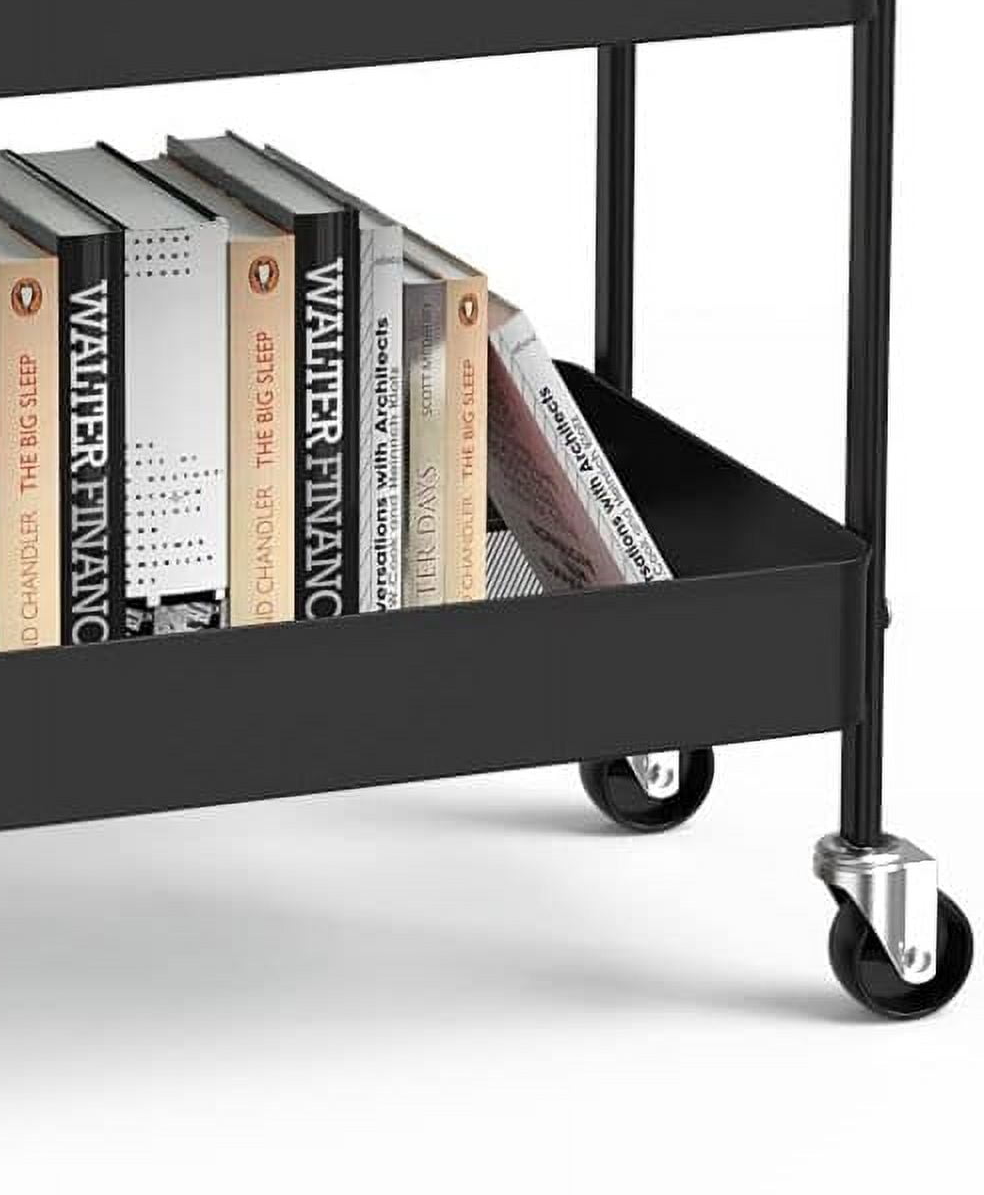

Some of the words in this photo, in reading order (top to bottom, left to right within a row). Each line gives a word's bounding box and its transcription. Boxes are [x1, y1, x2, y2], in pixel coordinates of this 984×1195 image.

[69, 279, 108, 472] WALTER
[256, 331, 274, 385] SLEEP
[305, 257, 343, 449] WALTER
[374, 317, 388, 434] Architects
[19, 354, 38, 407] SLEEP
[421, 372, 433, 417] SCOTT
[462, 359, 474, 405] SLEEP
[256, 389, 274, 423] BIG
[462, 410, 474, 440] BIG
[539, 386, 593, 472] Architects
[19, 414, 38, 447] BIG
[256, 430, 274, 469] THE
[19, 451, 38, 495] THE
[374, 442, 388, 490] with
[462, 443, 474, 480] THE
[416, 465, 437, 535] DAYS
[590, 476, 615, 514] with
[255, 485, 274, 594] CHANDLER
[20, 511, 39, 620] CHANDLER
